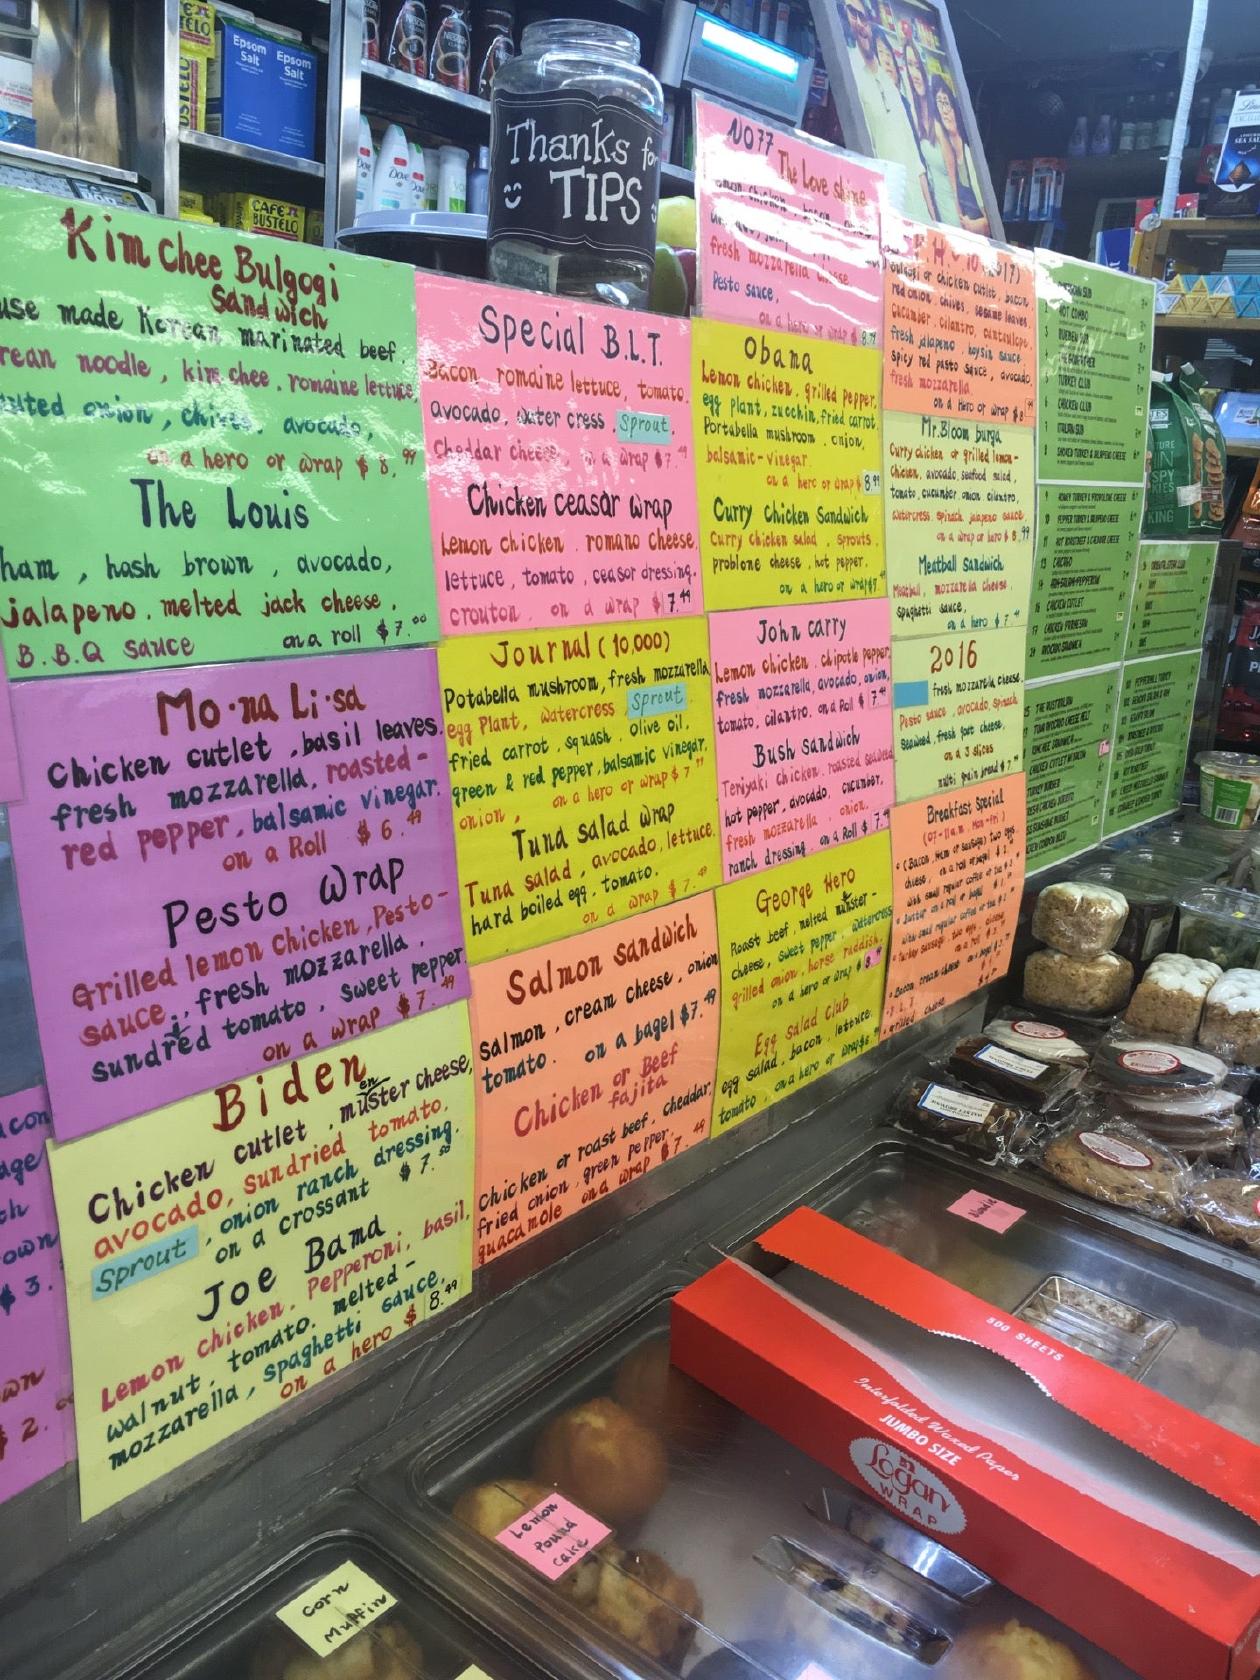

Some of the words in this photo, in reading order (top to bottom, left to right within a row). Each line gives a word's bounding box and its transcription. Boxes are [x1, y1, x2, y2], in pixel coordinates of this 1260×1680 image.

[233, 34, 267, 55] Epsom
[241, 52, 260, 66] Salt
[277, 51, 312, 69] Epsom
[284, 66, 304, 80] Salt
[506, 118, 630, 165] Thanks
[550, 166, 642, 225] TIPS
[234, 246, 340, 306] Bulgogi
[59, 298, 123, 330] made
[479, 305, 584, 354] Special
[744, 336, 814, 374] Obama
[805, 383, 837, 407] grilled
[203, 450, 249, 471] hero
[267, 453, 286, 471] or
[131, 478, 196, 528] The
[227, 486, 310, 530] Louis
[714, 496, 752, 530] Curry
[184, 550, 254, 576] brown
[163, 588, 241, 618] melted
[261, 588, 306, 617] jack
[123, 636, 195, 660] sauce
[331, 618, 361, 644] roll
[490, 631, 590, 668] Journal
[757, 619, 801, 644] John
[930, 640, 977, 673] 2016
[608, 666, 646, 689] fresh
[717, 690, 749, 707] fresh
[187, 736, 271, 769] cutlet
[449, 753, 491, 772] fried
[503, 737, 550, 761] carrot
[753, 744, 795, 769] Bush
[452, 782, 497, 807] green
[523, 768, 545, 788] red
[51, 795, 136, 832] fresh
[725, 808, 743, 828] hot
[62, 833, 117, 870] red
[251, 796, 346, 834] balsamic
[512, 828, 568, 861] Tuna
[577, 812, 630, 844] salad
[726, 834, 756, 852] fresh
[222, 852, 252, 872] on
[265, 844, 279, 863] a
[729, 850, 757, 876] ranch
[465, 882, 514, 908] Tuna
[525, 860, 571, 886] salad
[756, 881, 813, 916] George
[163, 889, 288, 949] Pesto
[471, 906, 514, 936] hard
[521, 889, 563, 917] boiled
[186, 937, 263, 981] lemon
[195, 977, 269, 1015] fresh
[506, 952, 603, 1006] Salmon
[222, 999, 306, 1039] tomato
[340, 969, 400, 1002] sweet
[565, 992, 616, 1026] cream
[585, 1042, 607, 1063] on
[615, 1033, 626, 1050] a
[634, 1011, 674, 1046] bagel
[754, 1032, 777, 1058] Egg
[612, 1068, 630, 1088] or
[746, 1056, 777, 1082] salad
[212, 1054, 368, 1133] Biden
[234, 1123, 307, 1164] cutlet
[578, 1131, 616, 1162] roast
[243, 1133, 346, 1195] sundried
[220, 1198, 279, 1235] onion
[297, 1158, 359, 1202] ranch
[477, 1205, 519, 1238] fried
[528, 1179, 569, 1209] onion
[583, 1154, 620, 1183] green
[197, 1264, 276, 1323] Joe
[304, 1215, 386, 1274] Bama
[333, 1267, 399, 1316] melted
[264, 1311, 361, 1383] spaghetti
[351, 1326, 392, 1363] hero
[986, 1317, 1011, 1332] 500
[1016, 1332, 1064, 1361] SHEETS
[854, 1377, 925, 1424] Interfolded
[976, 1452, 1020, 1482] Paper
[879, 1414, 929, 1446] JUMBO
[928, 1443, 962, 1467] SIZE
[866, 1444, 950, 1513] Logan
[880, 1482, 938, 1525] WRAP
[302, 1580, 350, 1618] Corn
